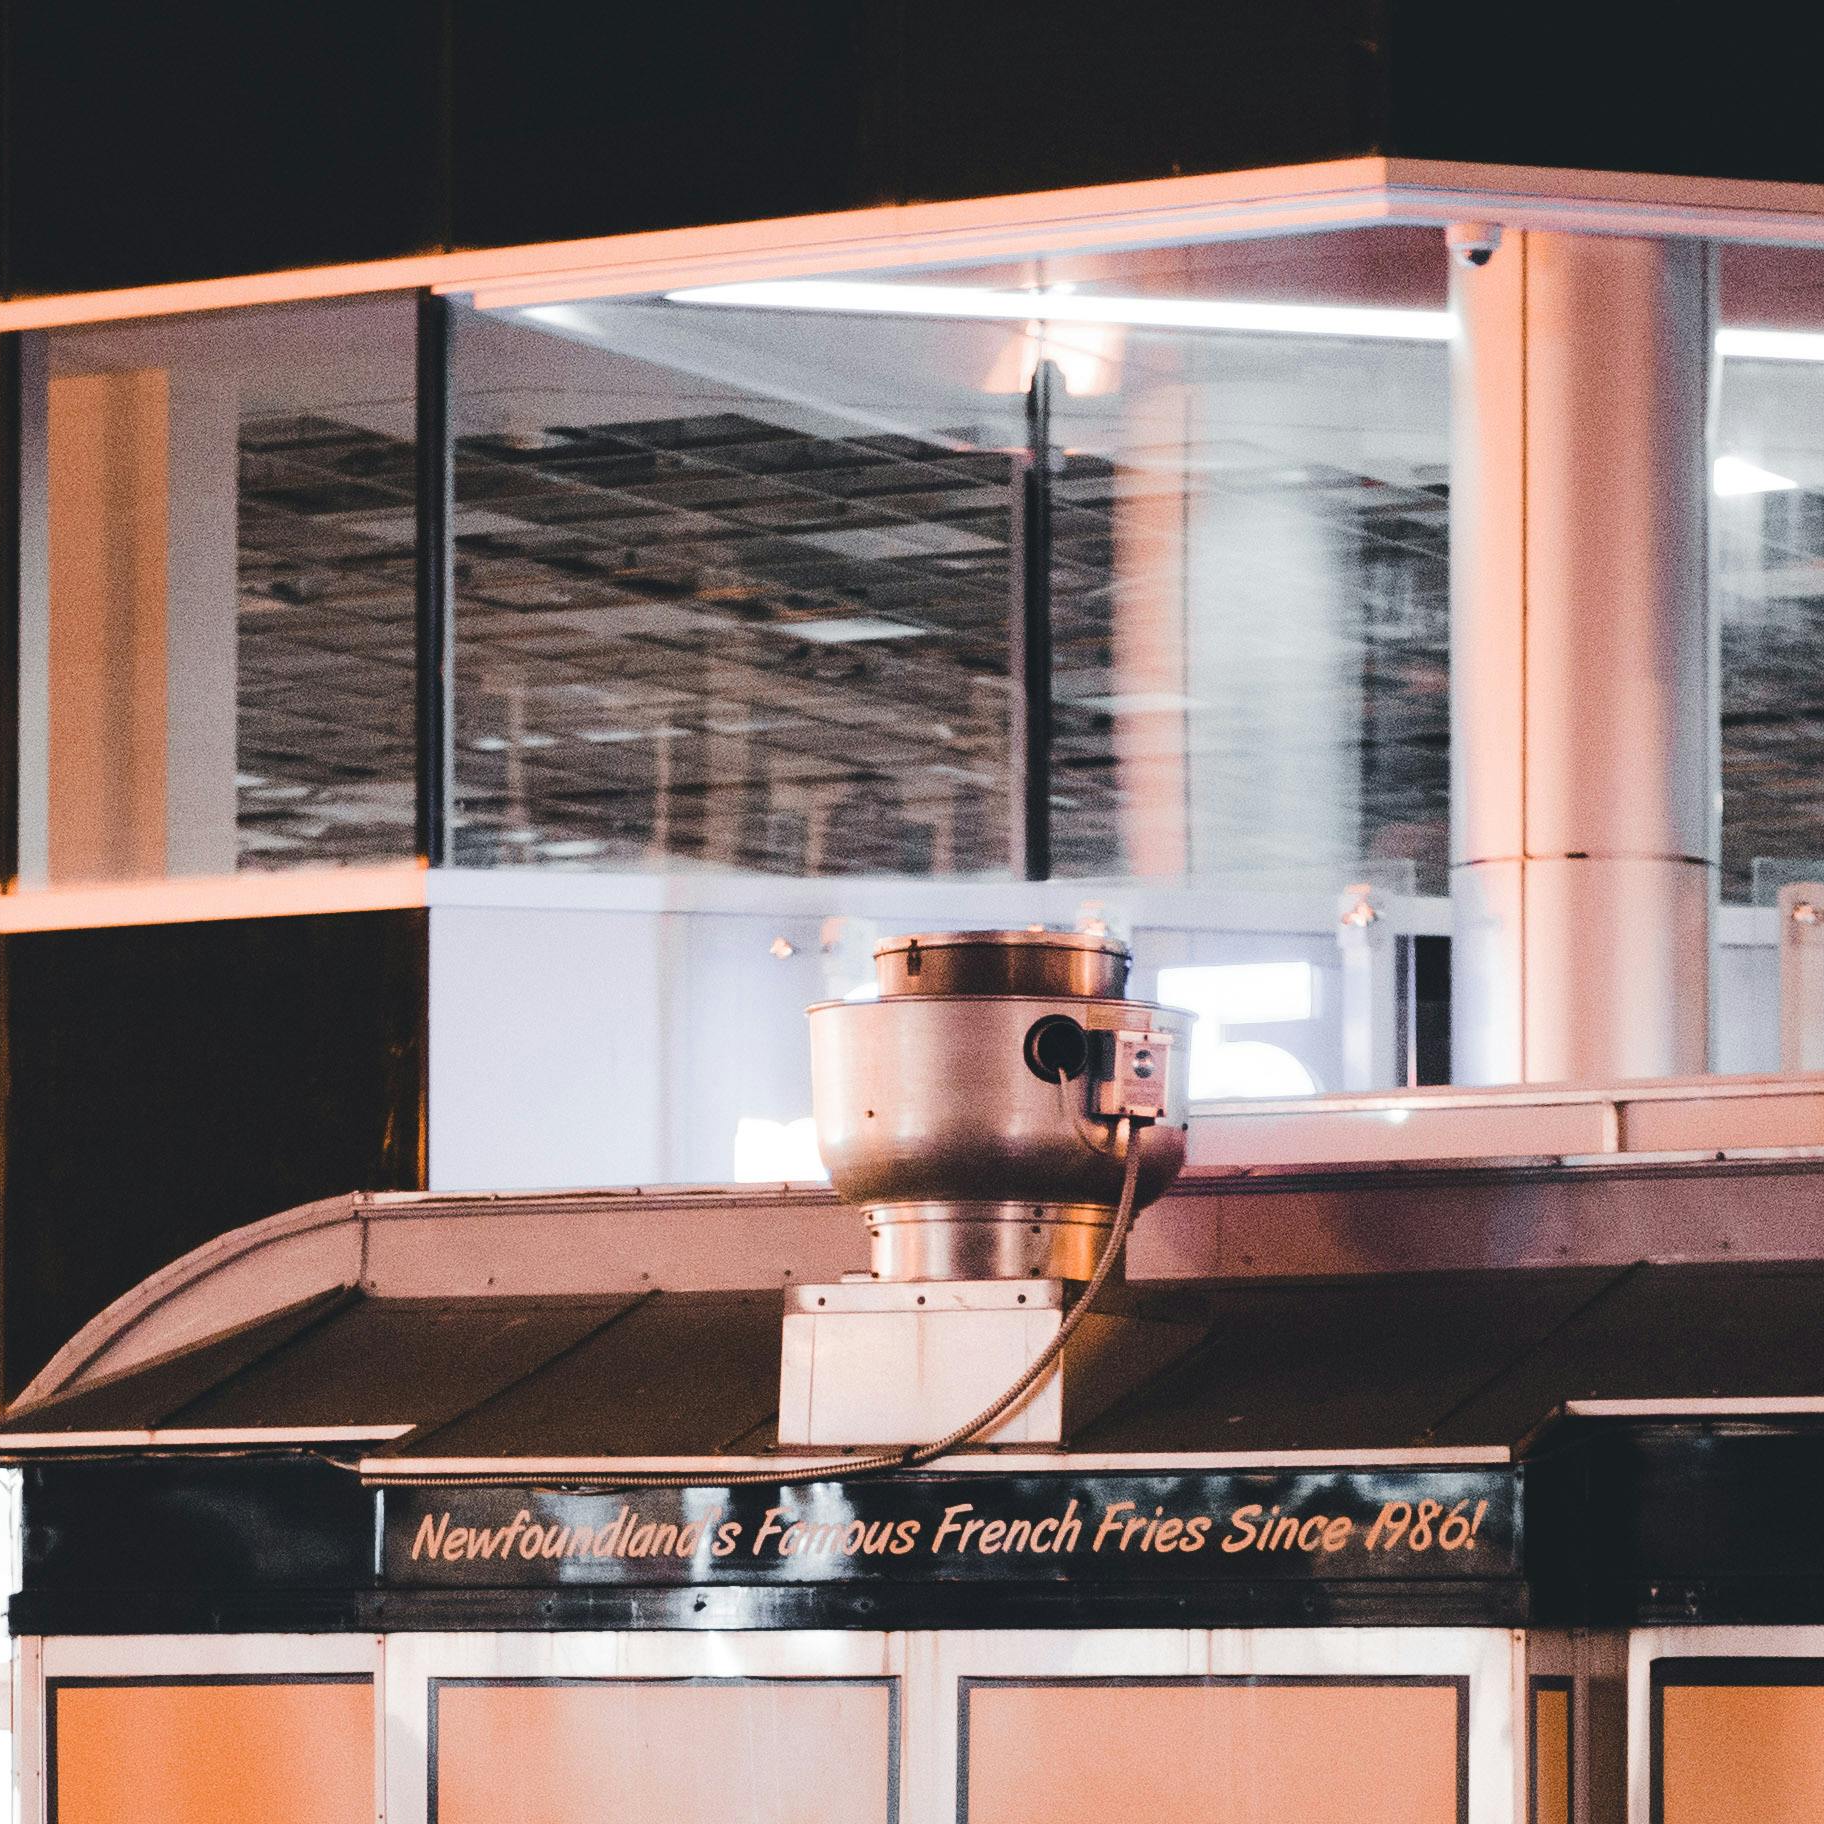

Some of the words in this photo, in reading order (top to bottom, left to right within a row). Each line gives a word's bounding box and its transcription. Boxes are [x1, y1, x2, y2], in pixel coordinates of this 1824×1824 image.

[410, 1504, 738, 1563] Newfoundland's
[752, 1507, 921, 1558] Famous
[930, 1500, 1082, 1555] French
[1092, 1501, 1213, 1554] Fries
[1220, 1503, 1348, 1554] Since
[1363, 1499, 1488, 1553] 1986!
